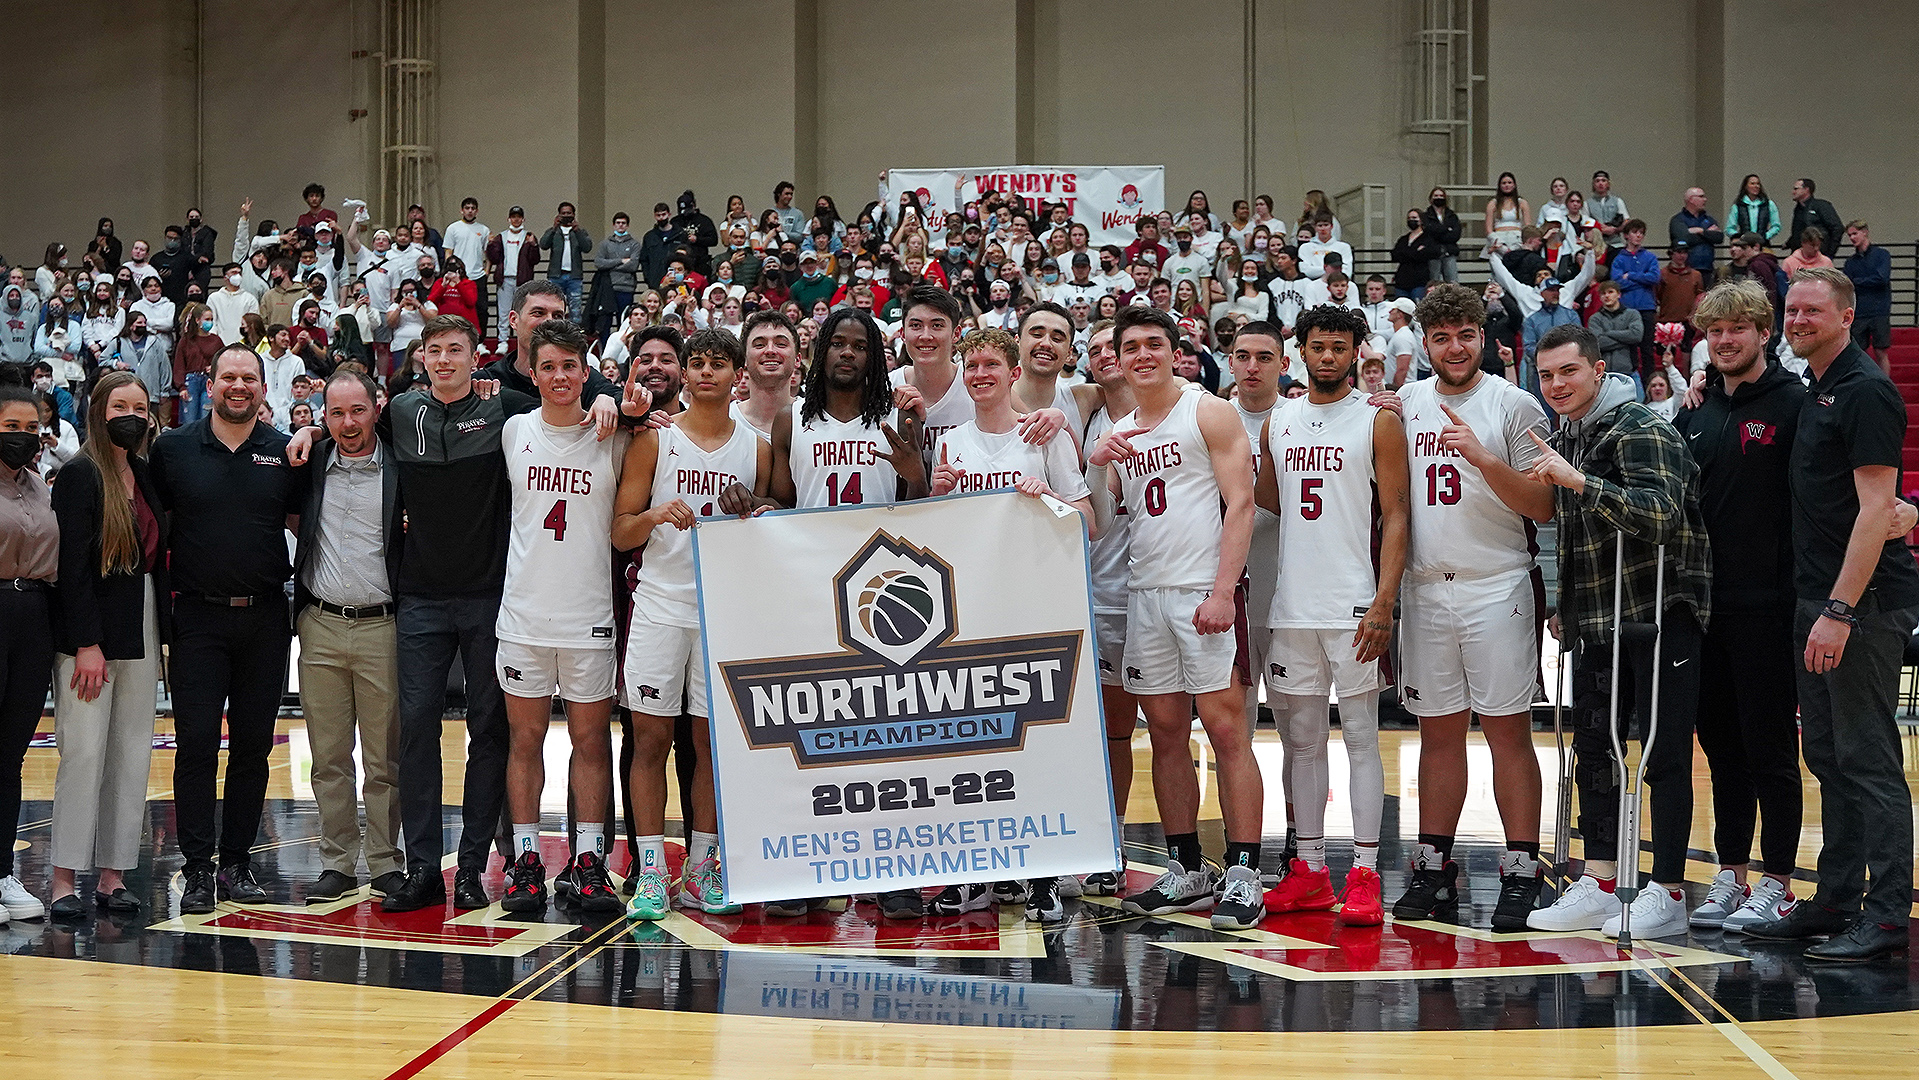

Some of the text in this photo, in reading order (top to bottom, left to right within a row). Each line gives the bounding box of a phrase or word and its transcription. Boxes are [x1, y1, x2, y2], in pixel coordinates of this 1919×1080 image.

[974, 173, 1077, 194] WENDY'S
[1102, 207, 1158, 230] Wend'
[1414, 431, 1460, 458] PIRA
[1746, 422, 1766, 439] W
[813, 440, 878, 467] PIRATES
[1125, 441, 1182, 480] PIRATES
[1285, 446, 1344, 472] PIRATES
[527, 466, 593, 495] PIRATES
[826, 472, 863, 506] 14
[1144, 476, 1168, 518] 0
[1425, 463, 1461, 506] 13
[1300, 478, 1324, 521] 5
[543, 499, 567, 541] 4
[747, 658, 1062, 728] NORTHWEST
[813, 716, 1004, 751] CHAMPION
[811, 769, 1016, 817] 2021-22
[761, 812, 1077, 860] MEN'S BASKETBALL
[808, 844, 1030, 884] TOURNAMENT
